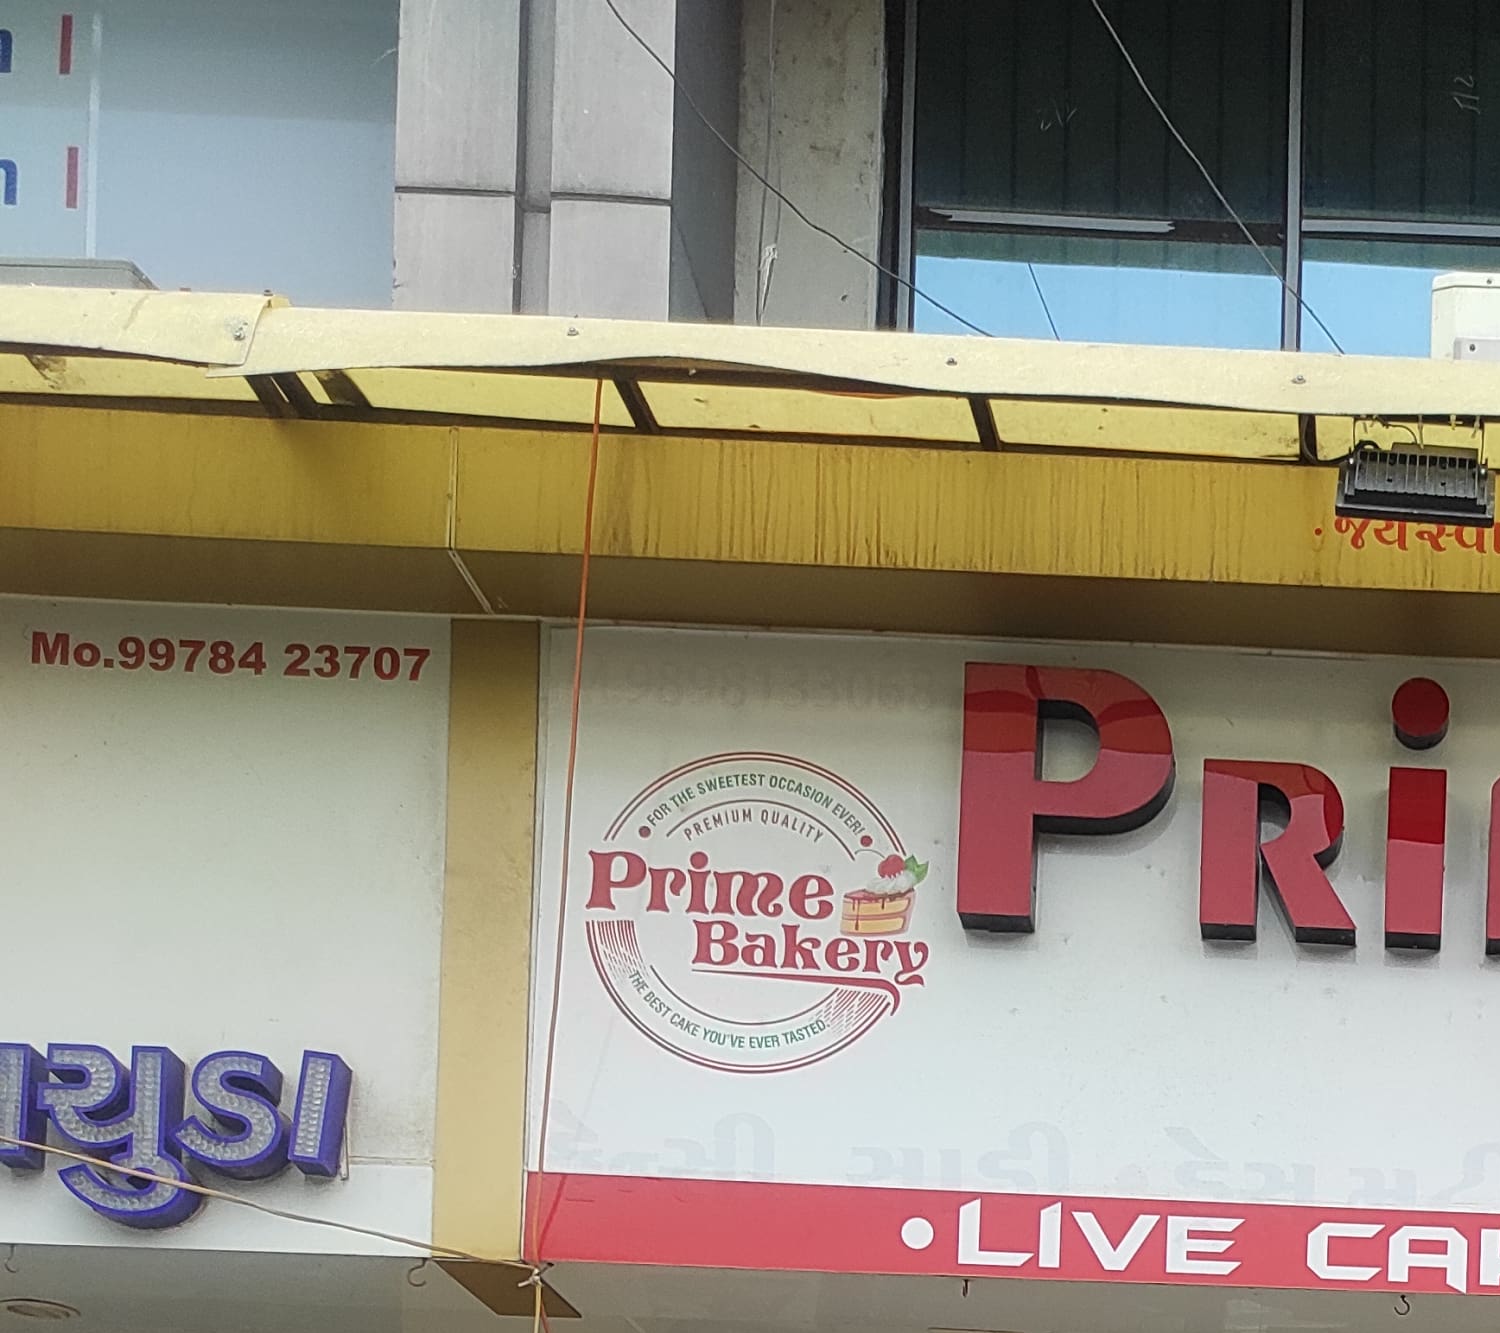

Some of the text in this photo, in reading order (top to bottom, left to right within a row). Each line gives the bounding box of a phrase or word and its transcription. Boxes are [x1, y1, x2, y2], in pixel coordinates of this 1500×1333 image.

[30, 630, 431, 682] Mo.99784 23707
[646, 774, 865, 837] FOR THE SWEETEST OCCASION EVER!
[683, 808, 825, 843] PREMIUM QUALITY
[585, 849, 835, 920] Prime
[691, 920, 929, 987] Bakery
[628, 969, 649, 995] THE
[645, 991, 672, 1019] BEST
[669, 1010, 700, 1037] CAKE
[702, 1027, 746, 1049] YOU'VE
[749, 1034, 781, 1050] EVER
[958, 1198, 1245, 1276] LIVE
